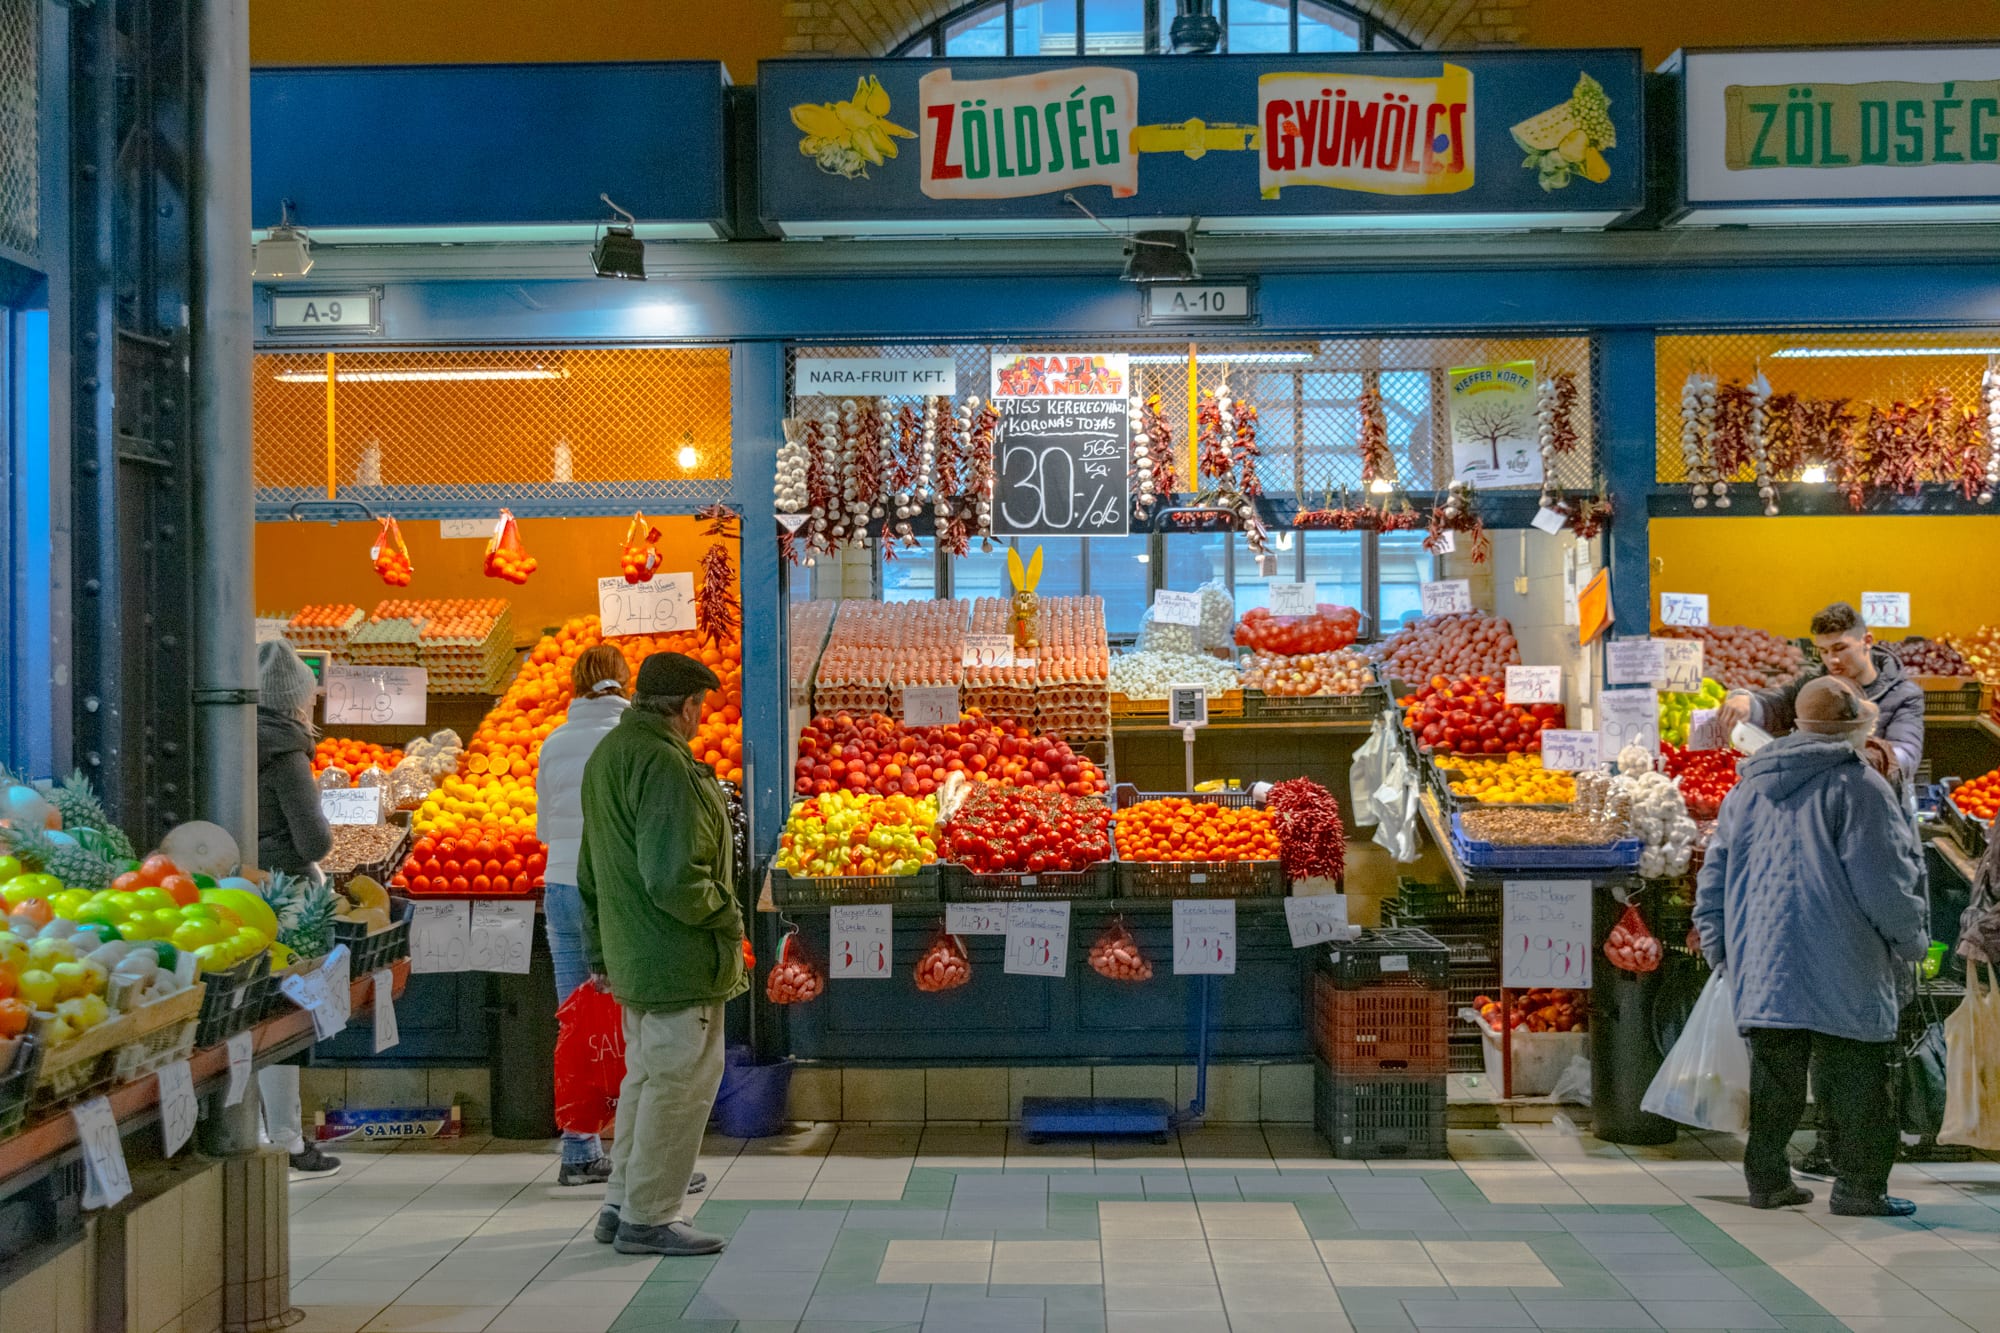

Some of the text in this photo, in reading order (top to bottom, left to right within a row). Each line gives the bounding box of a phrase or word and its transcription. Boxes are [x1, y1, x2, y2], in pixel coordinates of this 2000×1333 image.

[927, 86, 1467, 180] ZÖLDSÉG GYÜMÖLCS
[1748, 82, 2000, 166] ZÖLDSÉG
[1170, 291, 1226, 313] A-10
[303, 302, 343, 324] A-9
[1027, 356, 1093, 374] NAPI
[809, 370, 947, 384] NARA-FRUIT KFT.
[997, 375, 1123, 396] AJÁNLAT
[1454, 370, 1493, 393] KIEFFER
[1496, 370, 1531, 389] KÖRTE
[993, 399, 1041, 415] FRISS
[1009, 417, 1116, 433] KORONÁS TOJÁS
[364, 1123, 427, 1137] SAMBA
